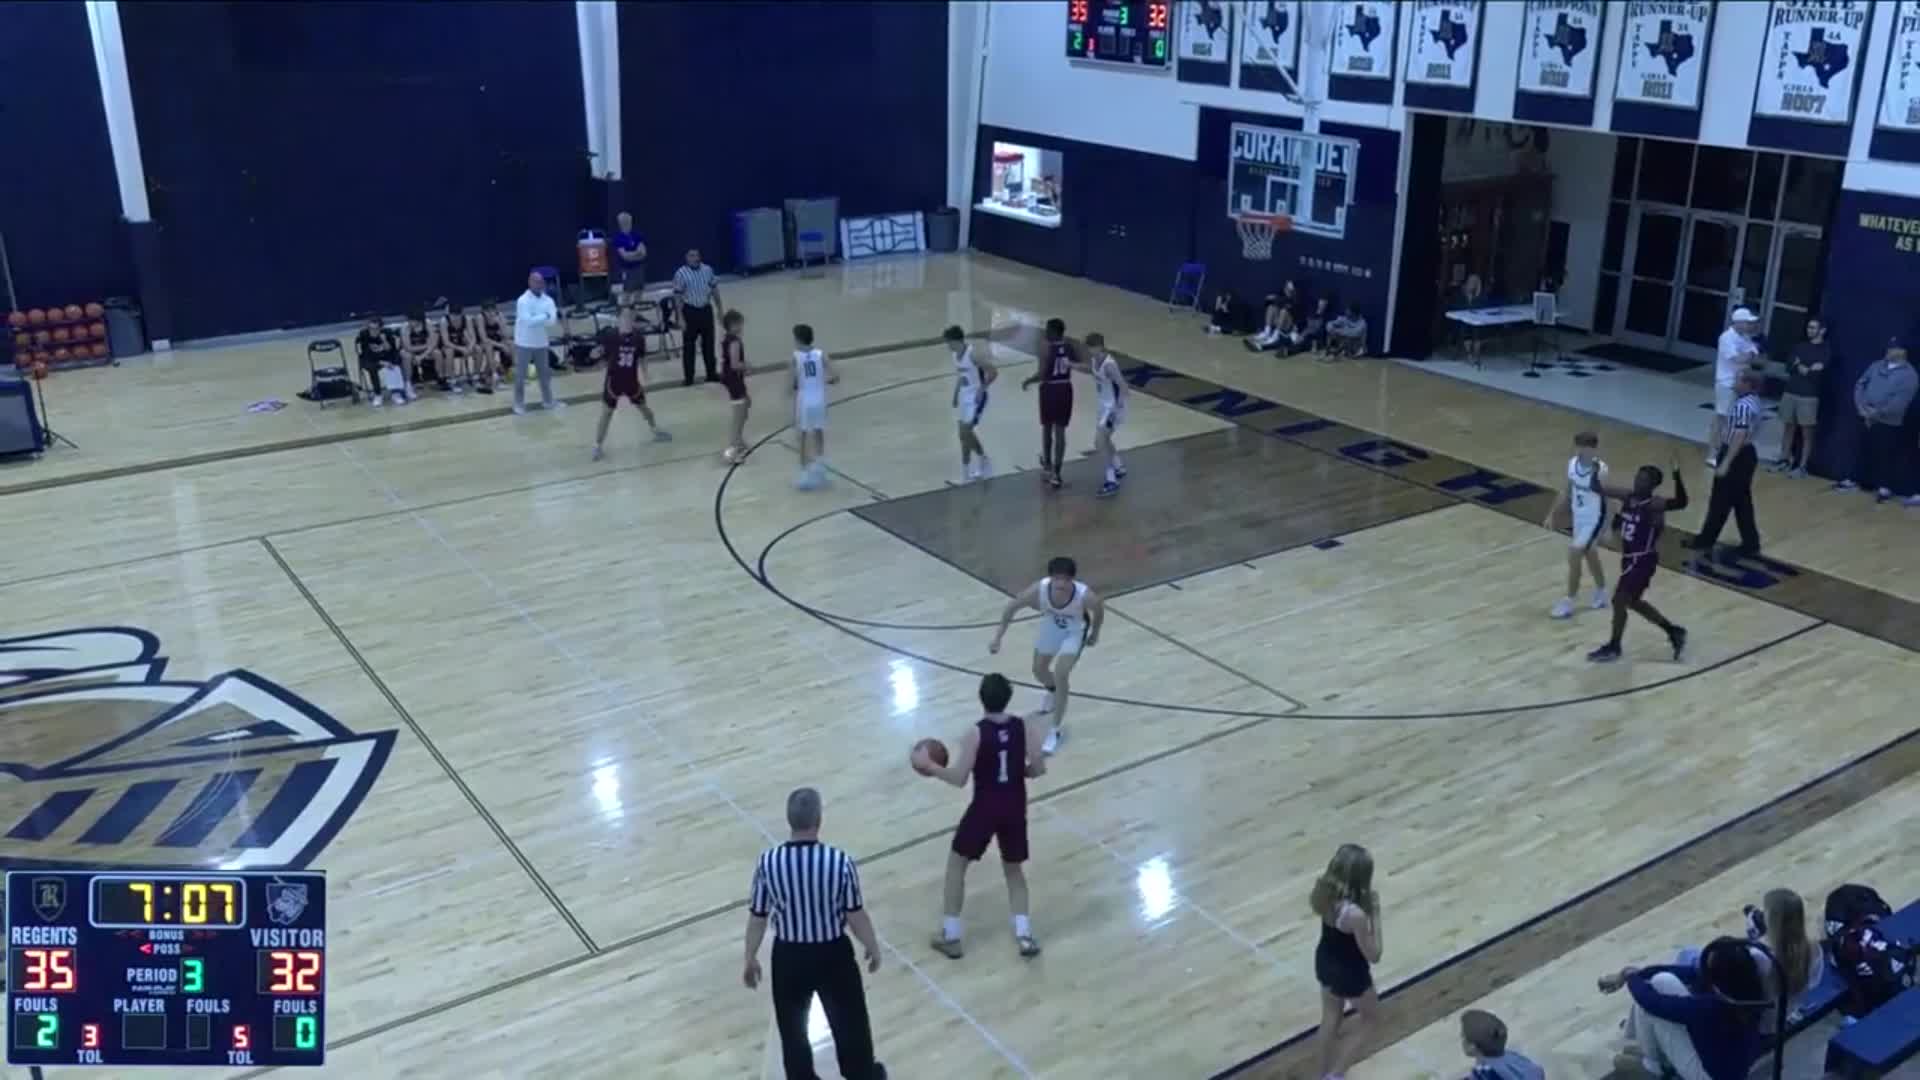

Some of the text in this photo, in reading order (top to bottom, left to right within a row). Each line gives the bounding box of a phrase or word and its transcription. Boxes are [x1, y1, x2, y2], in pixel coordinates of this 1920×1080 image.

[1119, 6, 1128, 25] 3
[1149, 4, 1167, 27] 32
[1630, 1, 1708, 22] RUNNER-UP
[1775, 8, 1864, 29] RUNNER-UP
[1072, 32, 1083, 49] 2
[1827, 31, 1841, 41] 4A
[1155, 40, 1164, 58] 0
[1777, 32, 1791, 80] TAPPS
[1899, 40, 1914, 90] TAPPS
[1783, 84, 1814, 93] GIRLS
[1859, 213, 1920, 236] WHATEVE
[1895, 236, 1913, 252] AS
[803, 361, 817, 377] 10
[1119, 363, 1799, 589] KNIGHS
[997, 750, 1009, 783] 1
